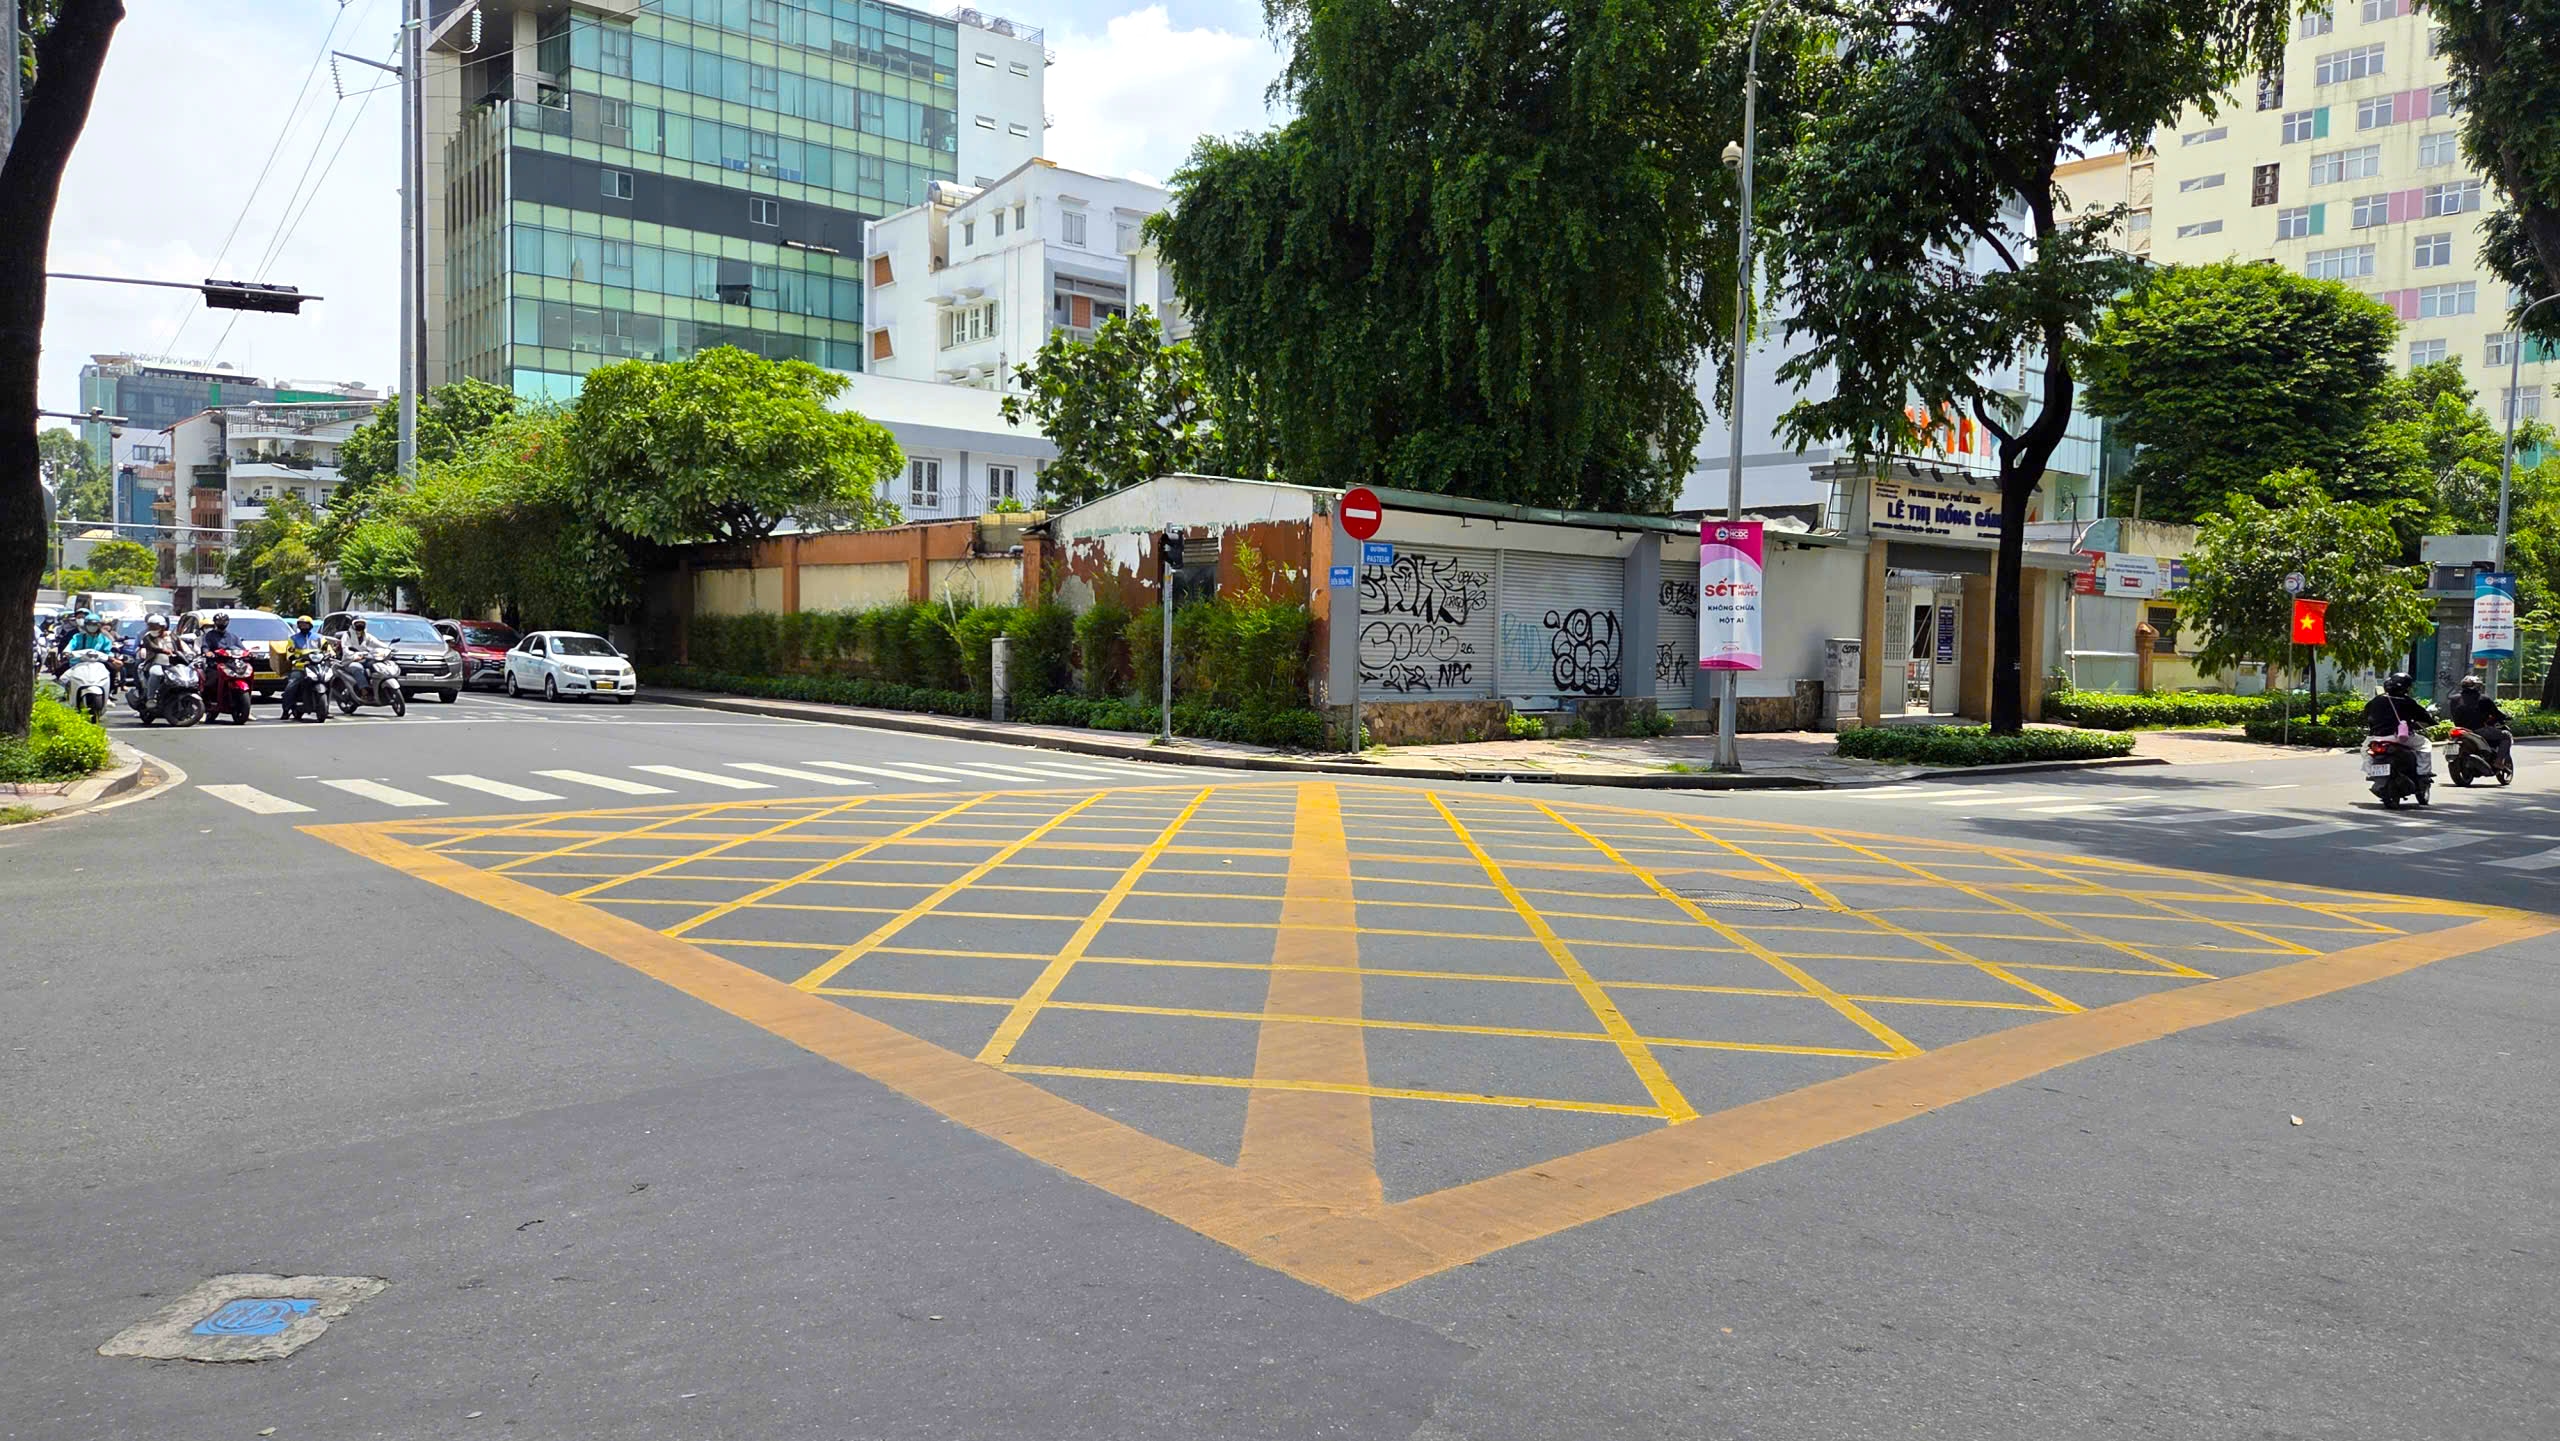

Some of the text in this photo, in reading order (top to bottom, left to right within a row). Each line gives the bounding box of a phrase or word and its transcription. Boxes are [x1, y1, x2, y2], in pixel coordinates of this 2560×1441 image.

[1887, 499, 1905, 519] LÊ
[1366, 555, 1390, 563] PASTEUR
[1705, 577, 1737, 597] SỐT
[1719, 617, 1735, 625] MỘT
[1438, 662, 1473, 688] NPC
